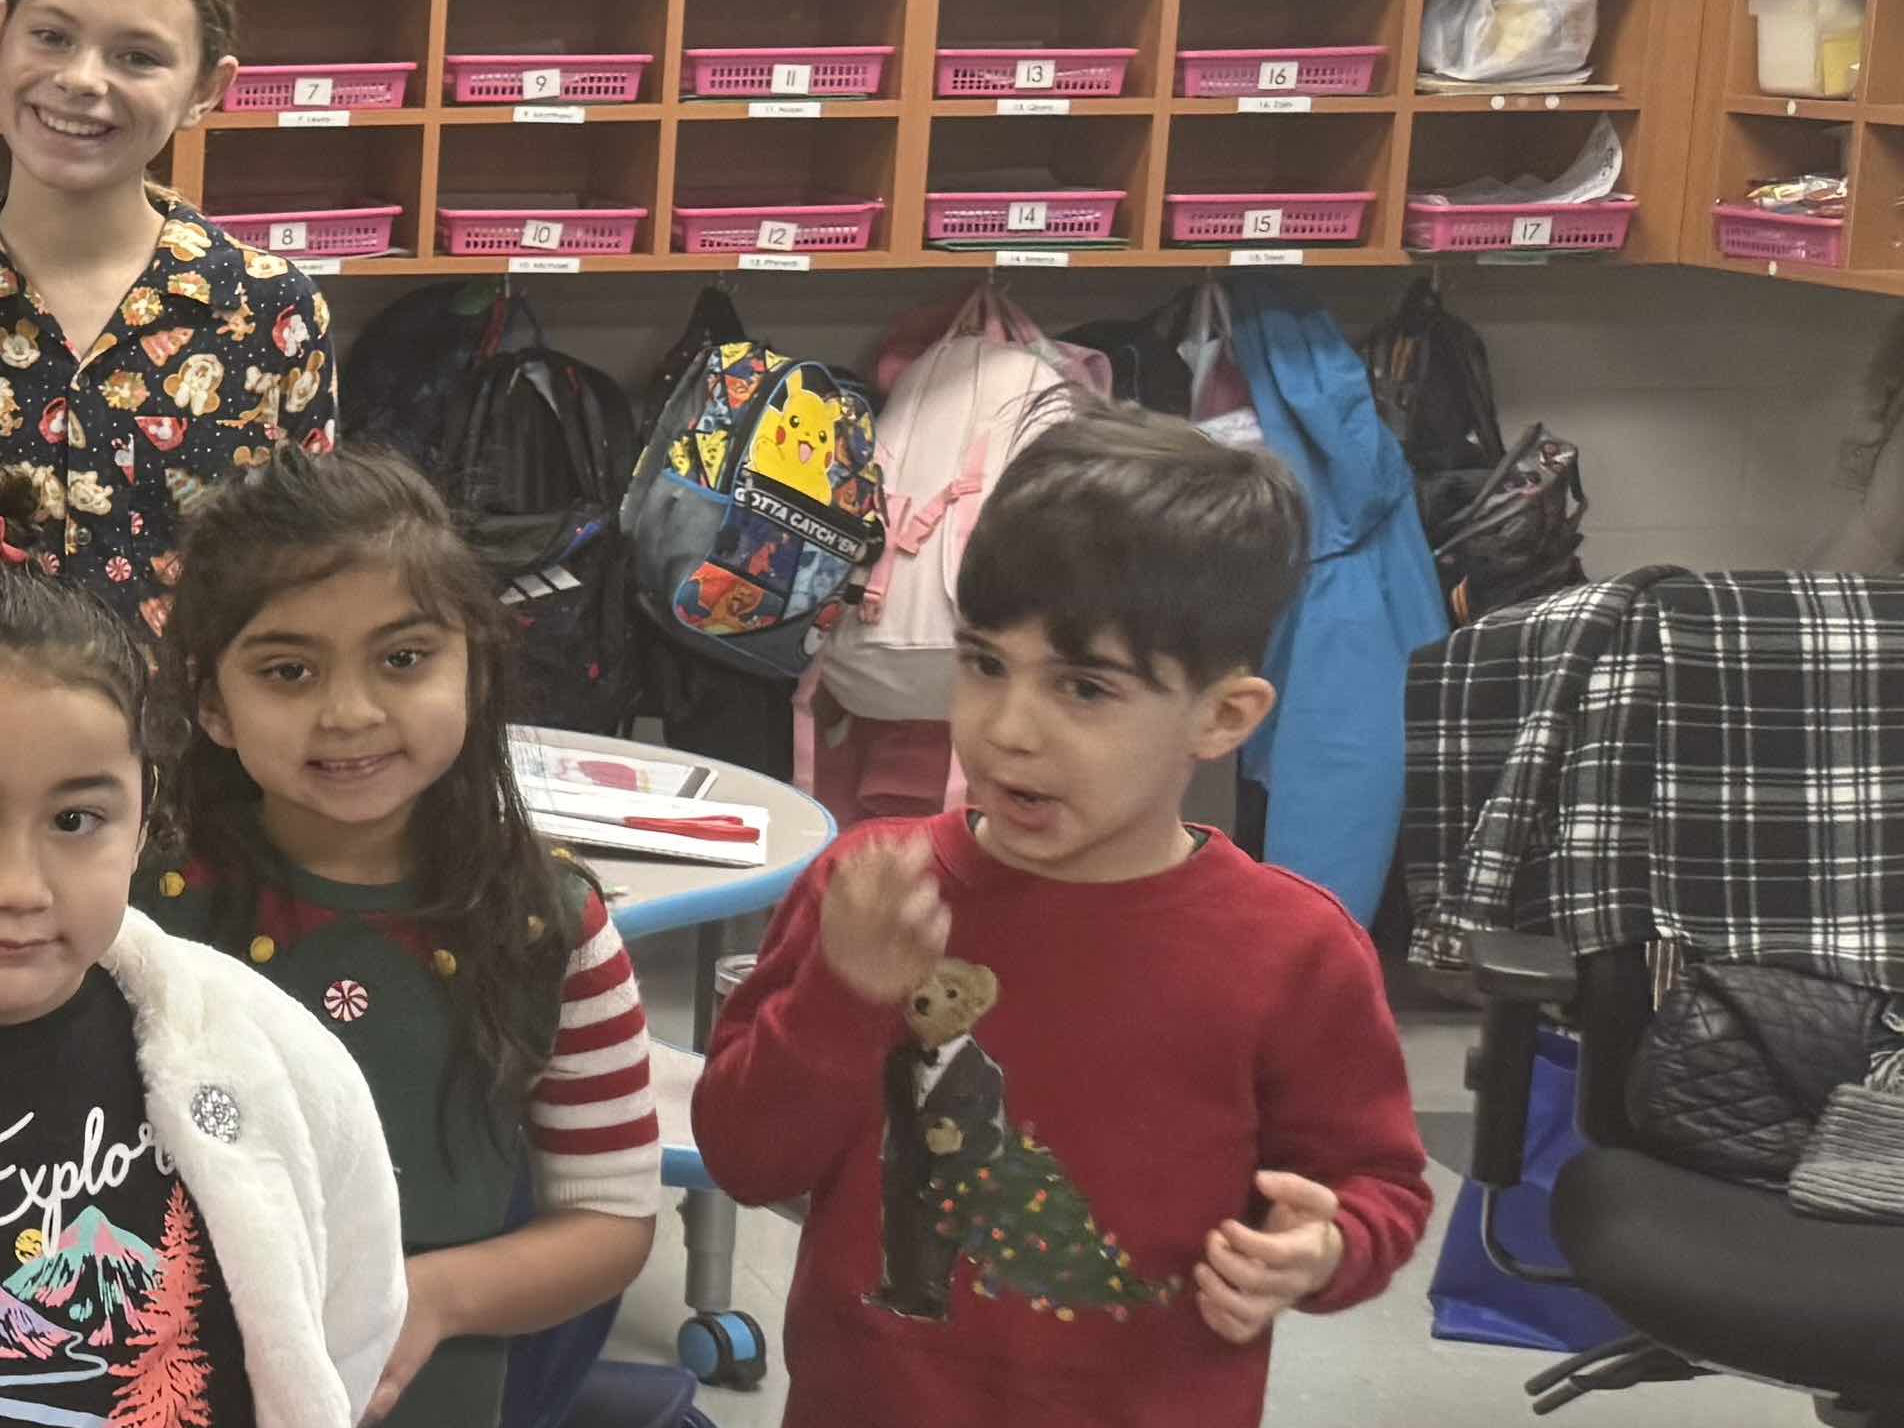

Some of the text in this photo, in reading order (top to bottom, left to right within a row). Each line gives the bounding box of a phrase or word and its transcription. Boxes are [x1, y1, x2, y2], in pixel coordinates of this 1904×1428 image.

[786, 70, 796, 87] 11
[1026, 65, 1043, 83] 13
[1269, 68, 1286, 85] 16
[308, 83, 319, 100] 7
[536, 75, 547, 92] 9
[1019, 207, 1036, 224] 14
[1254, 215, 1271, 232] 15
[282, 228, 293, 245] 8
[532, 225, 550, 243] 10
[768, 227, 787, 245] 12
[1522, 220, 1541, 240] 17
[790, 511, 834, 544] CATCH
